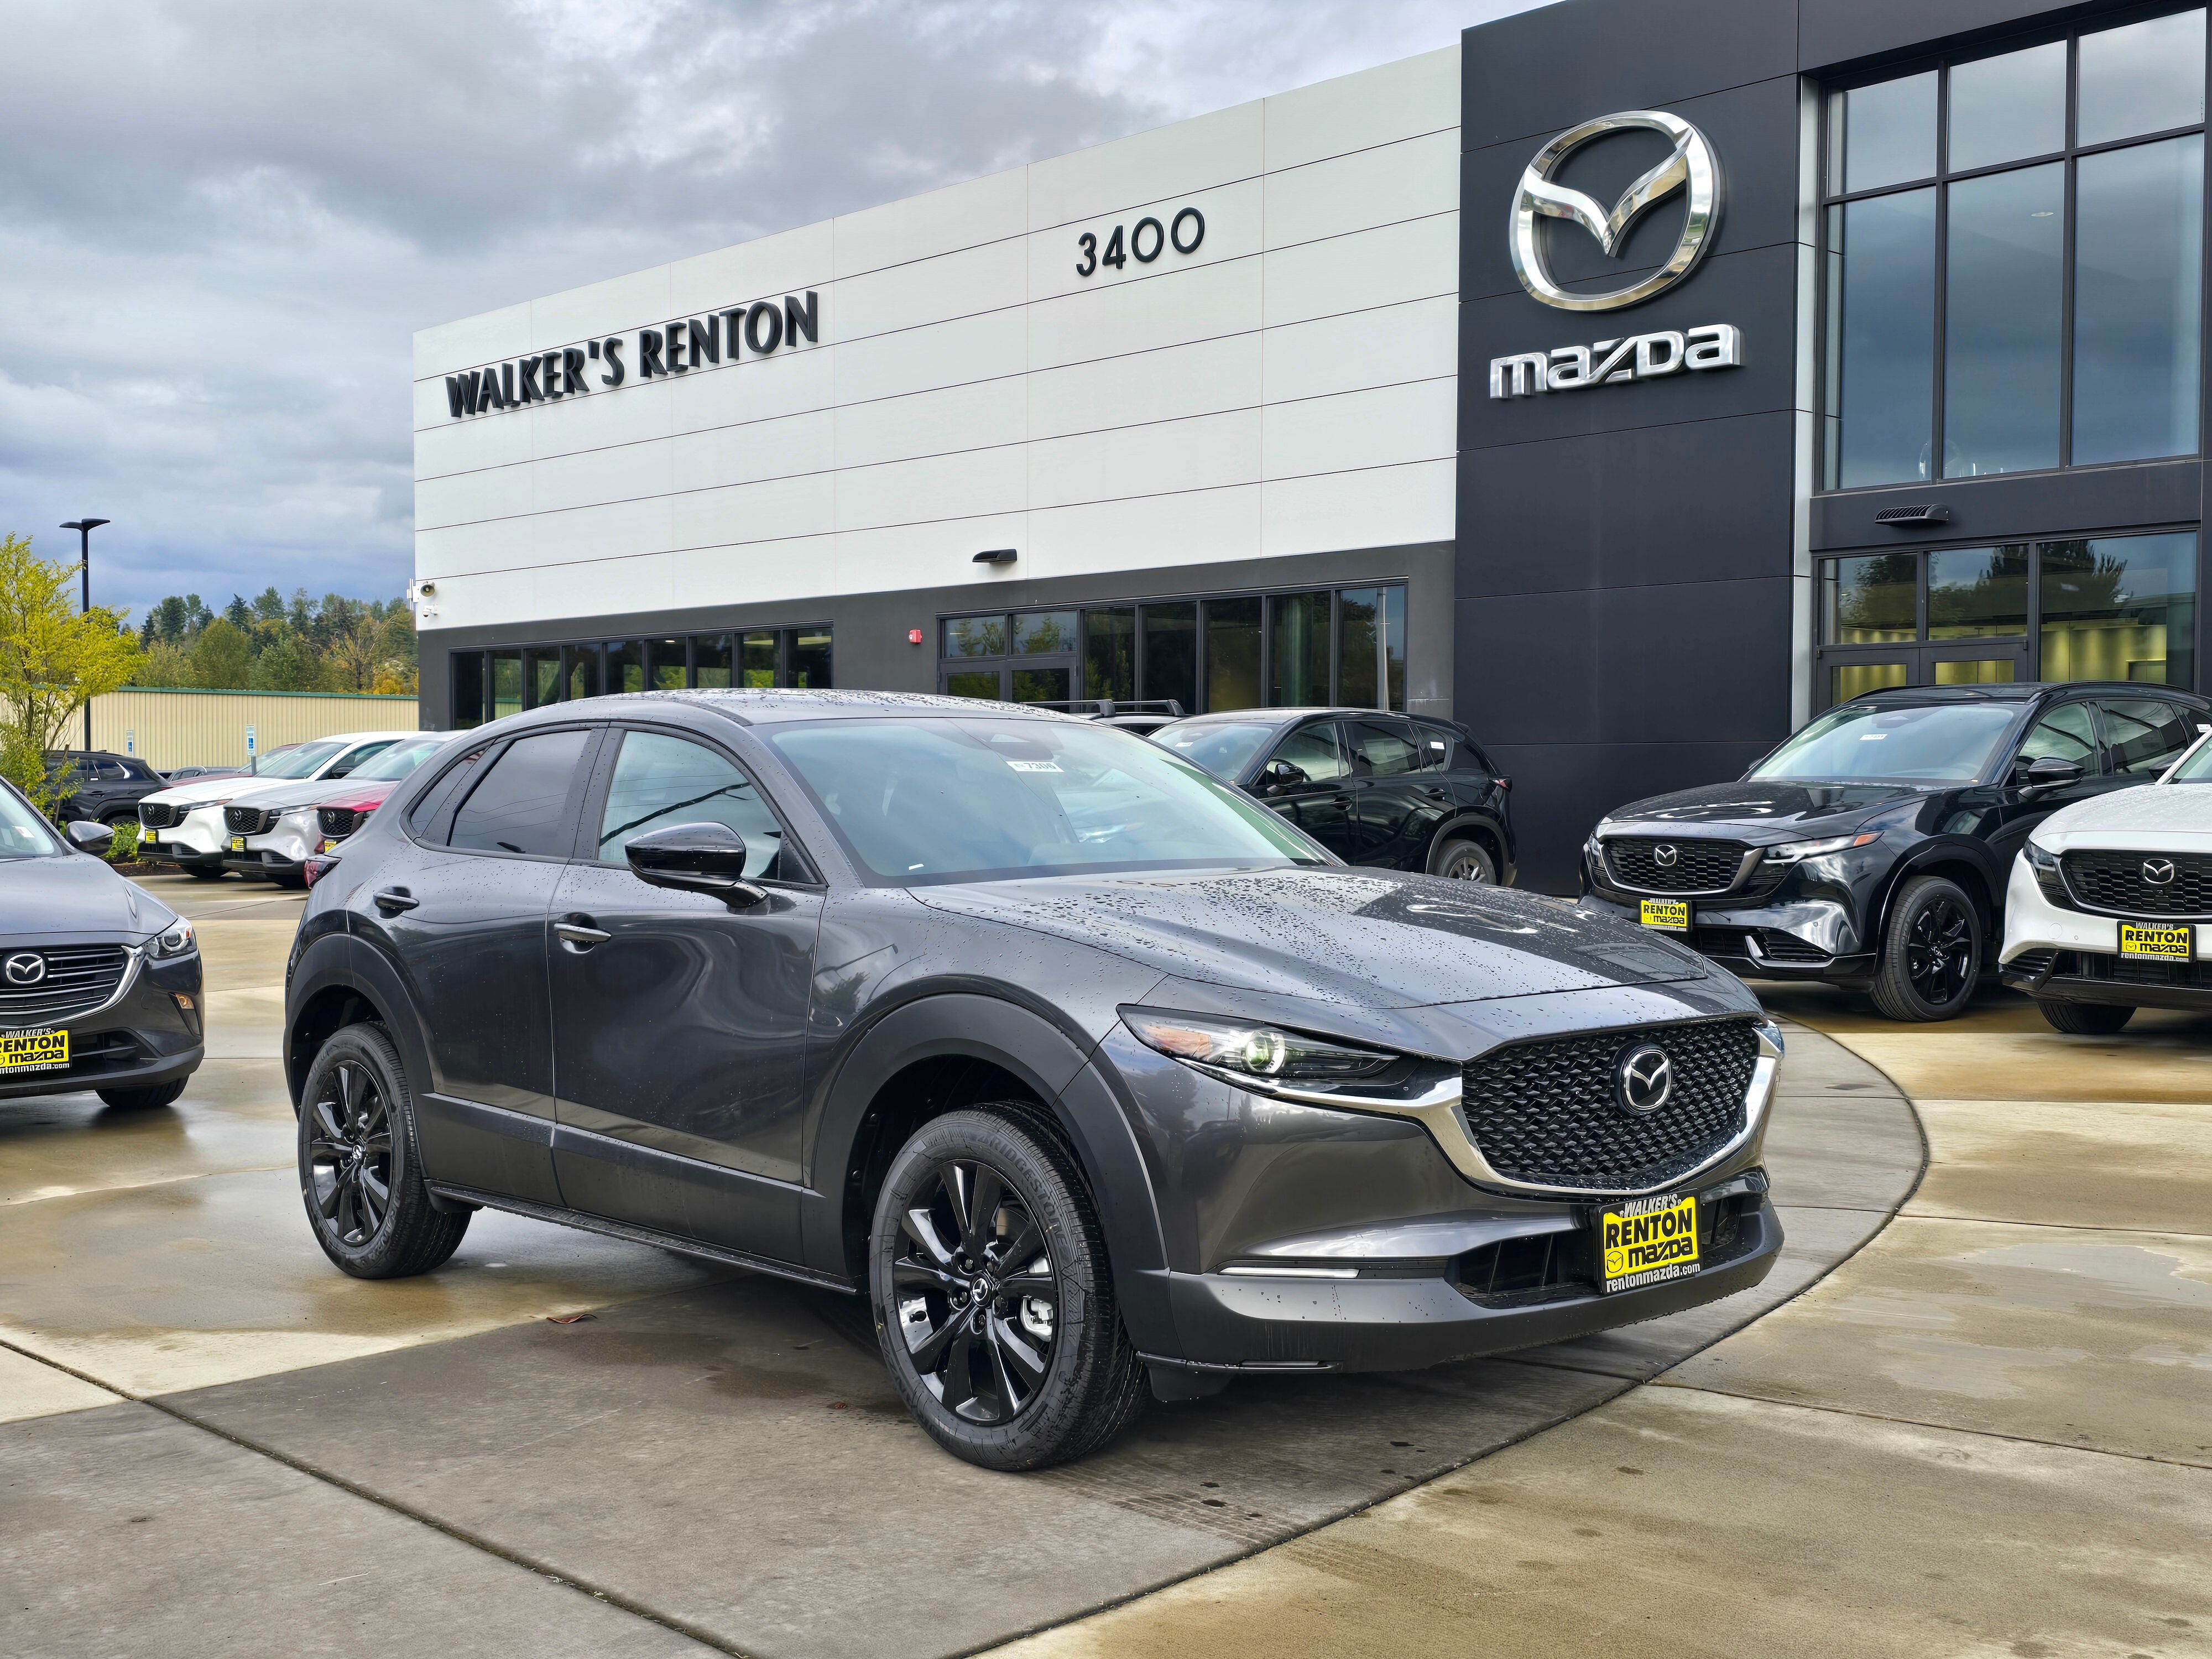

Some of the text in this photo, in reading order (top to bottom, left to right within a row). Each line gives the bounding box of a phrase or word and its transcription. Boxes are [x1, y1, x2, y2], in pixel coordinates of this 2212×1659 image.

[1076, 207, 1205, 276] 3400
[445, 290, 818, 418] WALKER'S RENTON
[1644, 905, 1685, 916] RENTON
[2125, 930, 2188, 943] RENTON
[2136, 922, 2173, 930] WALKER'S
[2121, 952, 2189, 962] rentonmazda.com
[6, 1028, 51, 1038] WALKER'S
[977, 1134, 1068, 1246] BRIDGESTONE
[1624, 1193, 1678, 1218] WALKER'S
[1605, 1208, 1692, 1249] RENTON
[1606, 1263, 1700, 1292] rentonmazda.com
